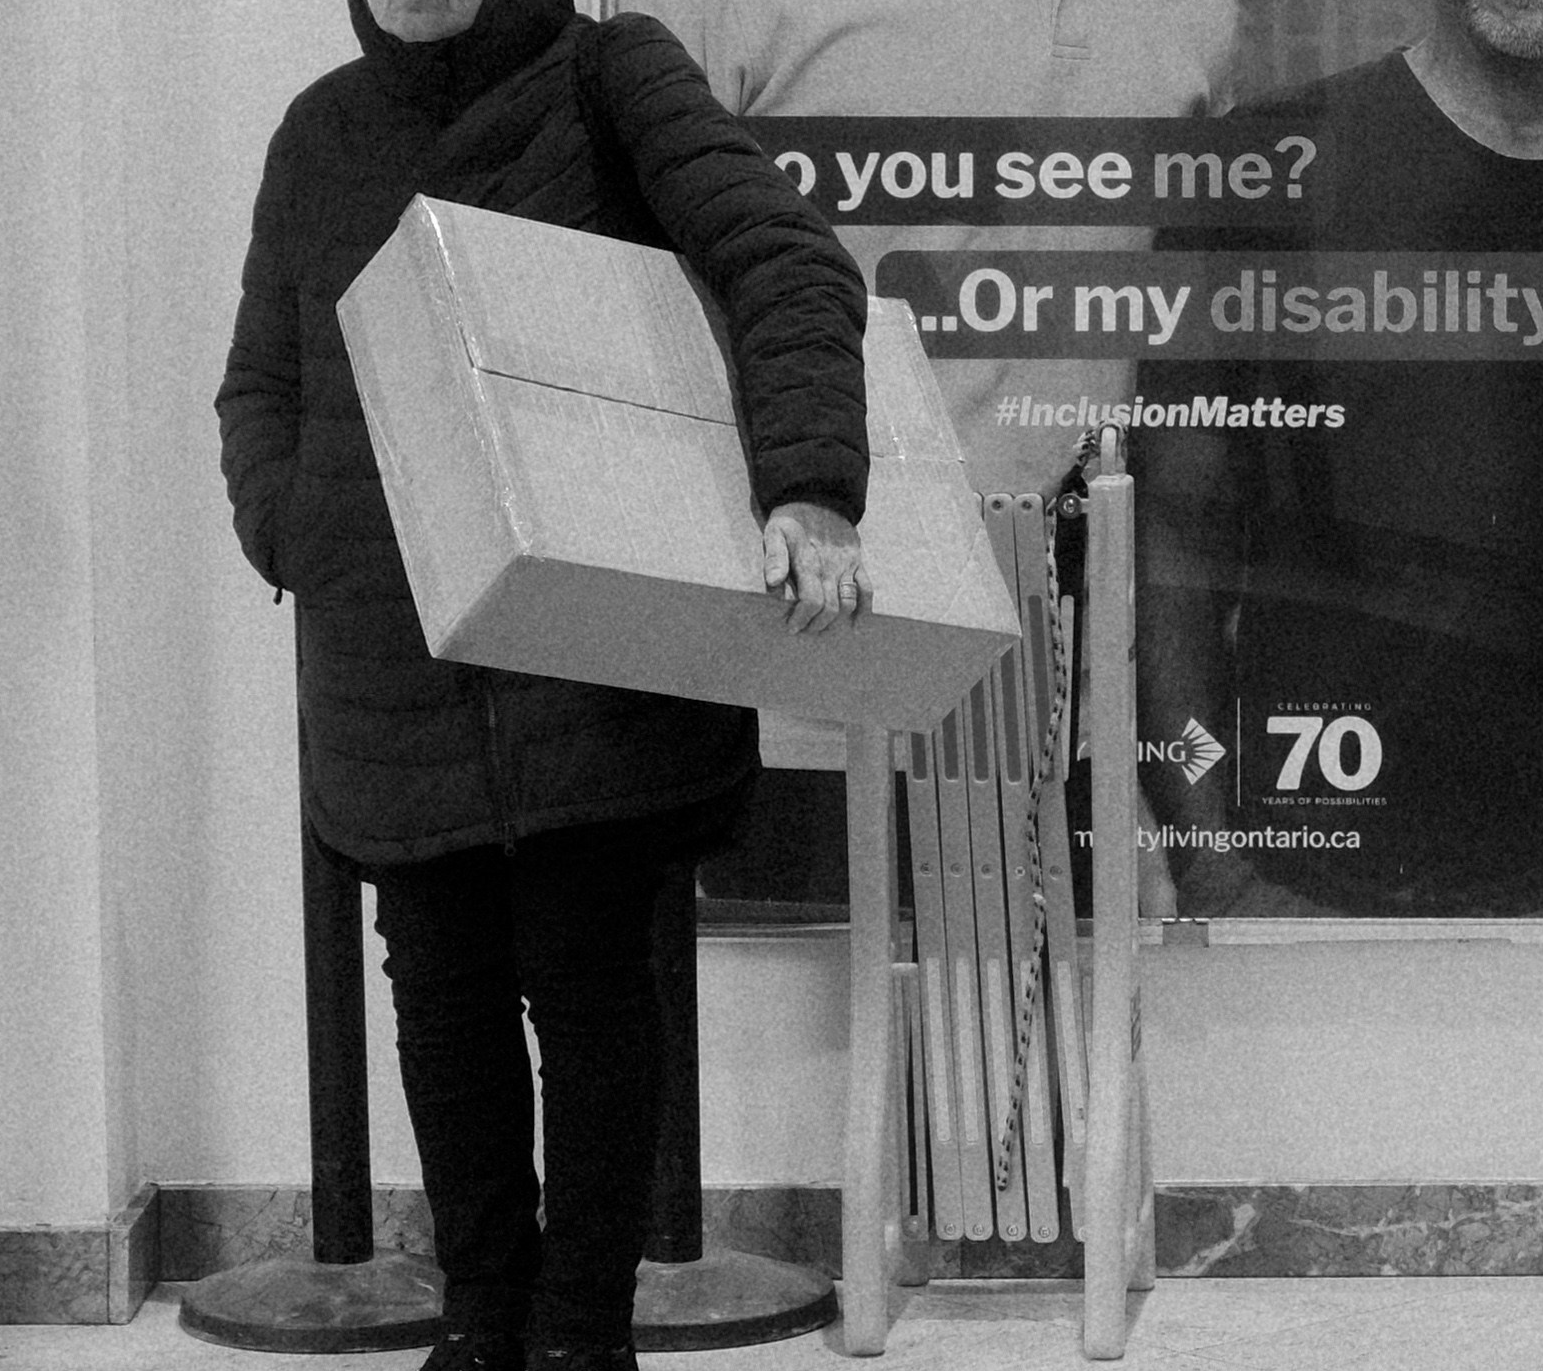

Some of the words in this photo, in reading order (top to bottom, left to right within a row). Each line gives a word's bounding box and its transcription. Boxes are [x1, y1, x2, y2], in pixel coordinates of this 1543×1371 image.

[773, 150, 817, 197] o
[835, 151, 975, 212] you
[994, 150, 1133, 199] see
[1153, 136, 1318, 199] me?
[1074, 281, 1191, 345] my
[995, 395, 1346, 428] #InclusionMatters
[1277, 702, 1372, 711] CELEBRATING
[1266, 715, 1383, 791] 70
[1261, 796, 1296, 806] YEARS
[1297, 796, 1312, 806] OF
[1314, 796, 1388, 806] POSSIBILITIES
